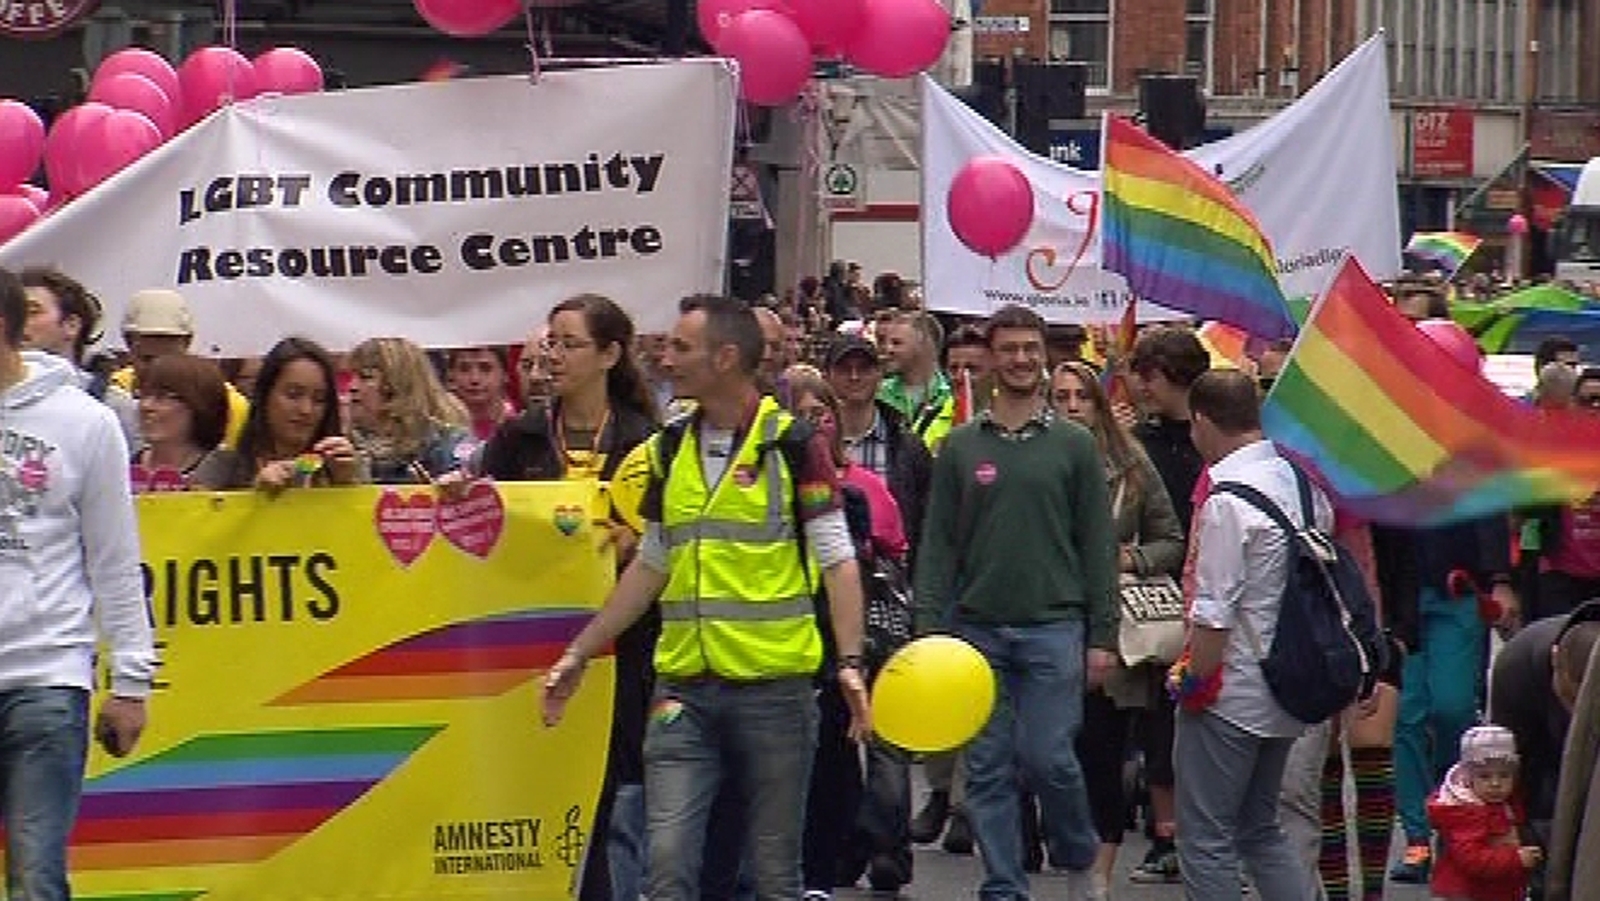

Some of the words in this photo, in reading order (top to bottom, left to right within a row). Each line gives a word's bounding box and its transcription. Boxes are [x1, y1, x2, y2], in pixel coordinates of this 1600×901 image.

[179, 173, 310, 225] LGBT
[328, 152, 665, 207] Community
[177, 243, 442, 284] Resource
[460, 223, 662, 271] Centre
[434, 818, 542, 851] AMNESTY
[434, 852, 543, 875] INTERNATIONAL
